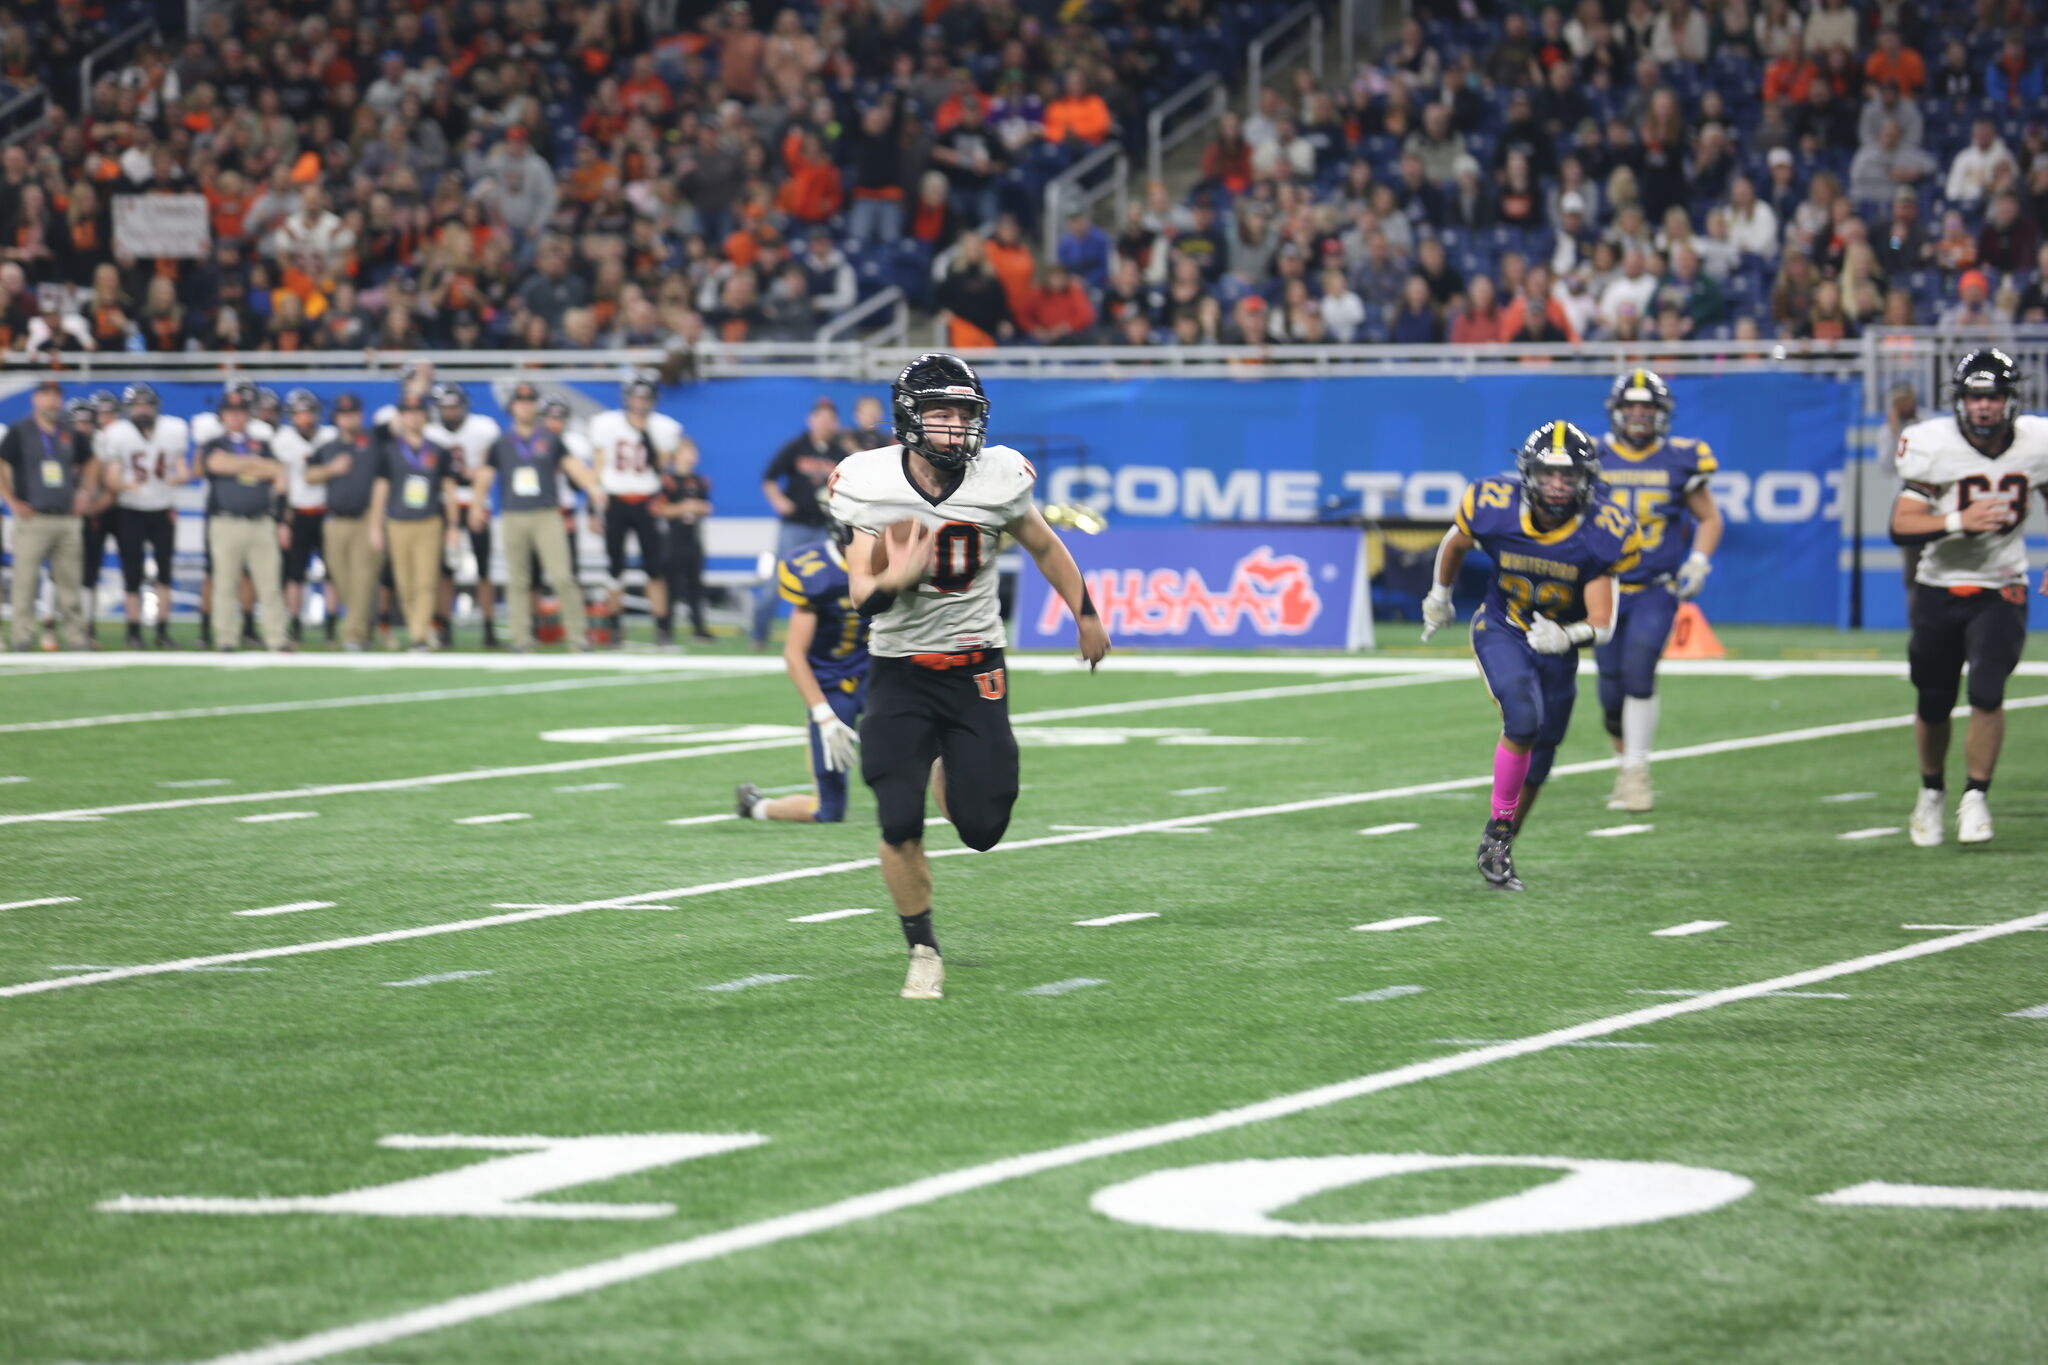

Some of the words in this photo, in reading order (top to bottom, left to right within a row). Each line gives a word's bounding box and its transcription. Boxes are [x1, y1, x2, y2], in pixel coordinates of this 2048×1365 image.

[1033, 465, 1322, 521] COME
[1343, 470, 1467, 524] TO
[1478, 481, 1515, 509] 22
[1594, 504, 1632, 540] 22
[791, 549, 827, 577] 14
[1499, 550, 1579, 581] WHITEFORD
[972, 667, 1007, 700] U
